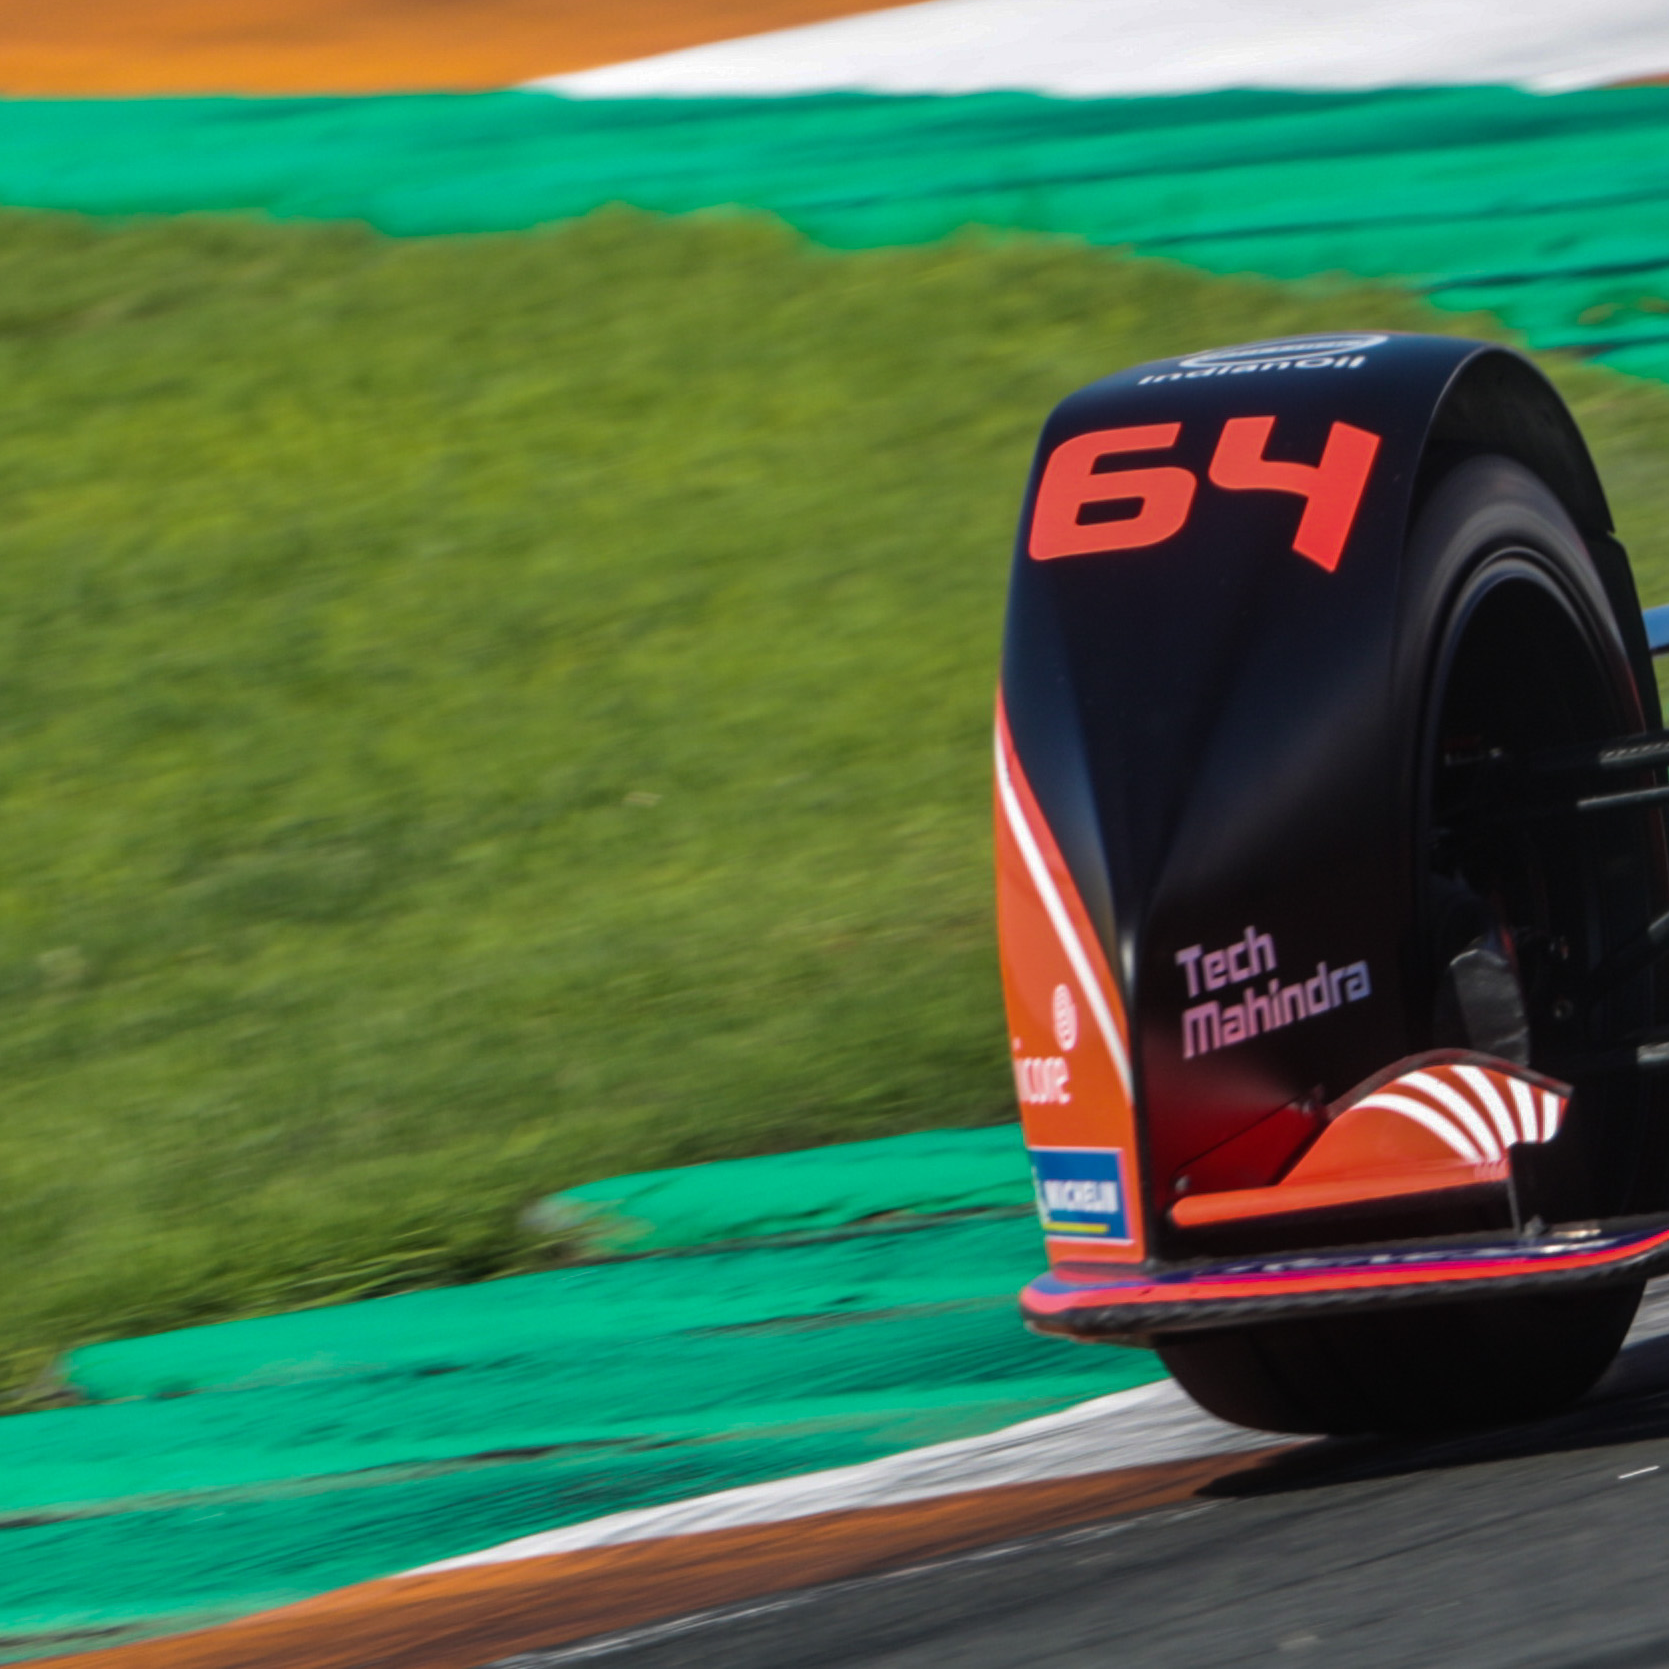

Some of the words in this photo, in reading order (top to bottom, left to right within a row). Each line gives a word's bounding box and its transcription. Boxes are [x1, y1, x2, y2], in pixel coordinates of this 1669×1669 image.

[1137, 355, 1366, 386] IndianOil
[1028, 415, 1381, 573] 64
[1175, 925, 1277, 999] Tech
[1182, 961, 1372, 1061] Mahindra
